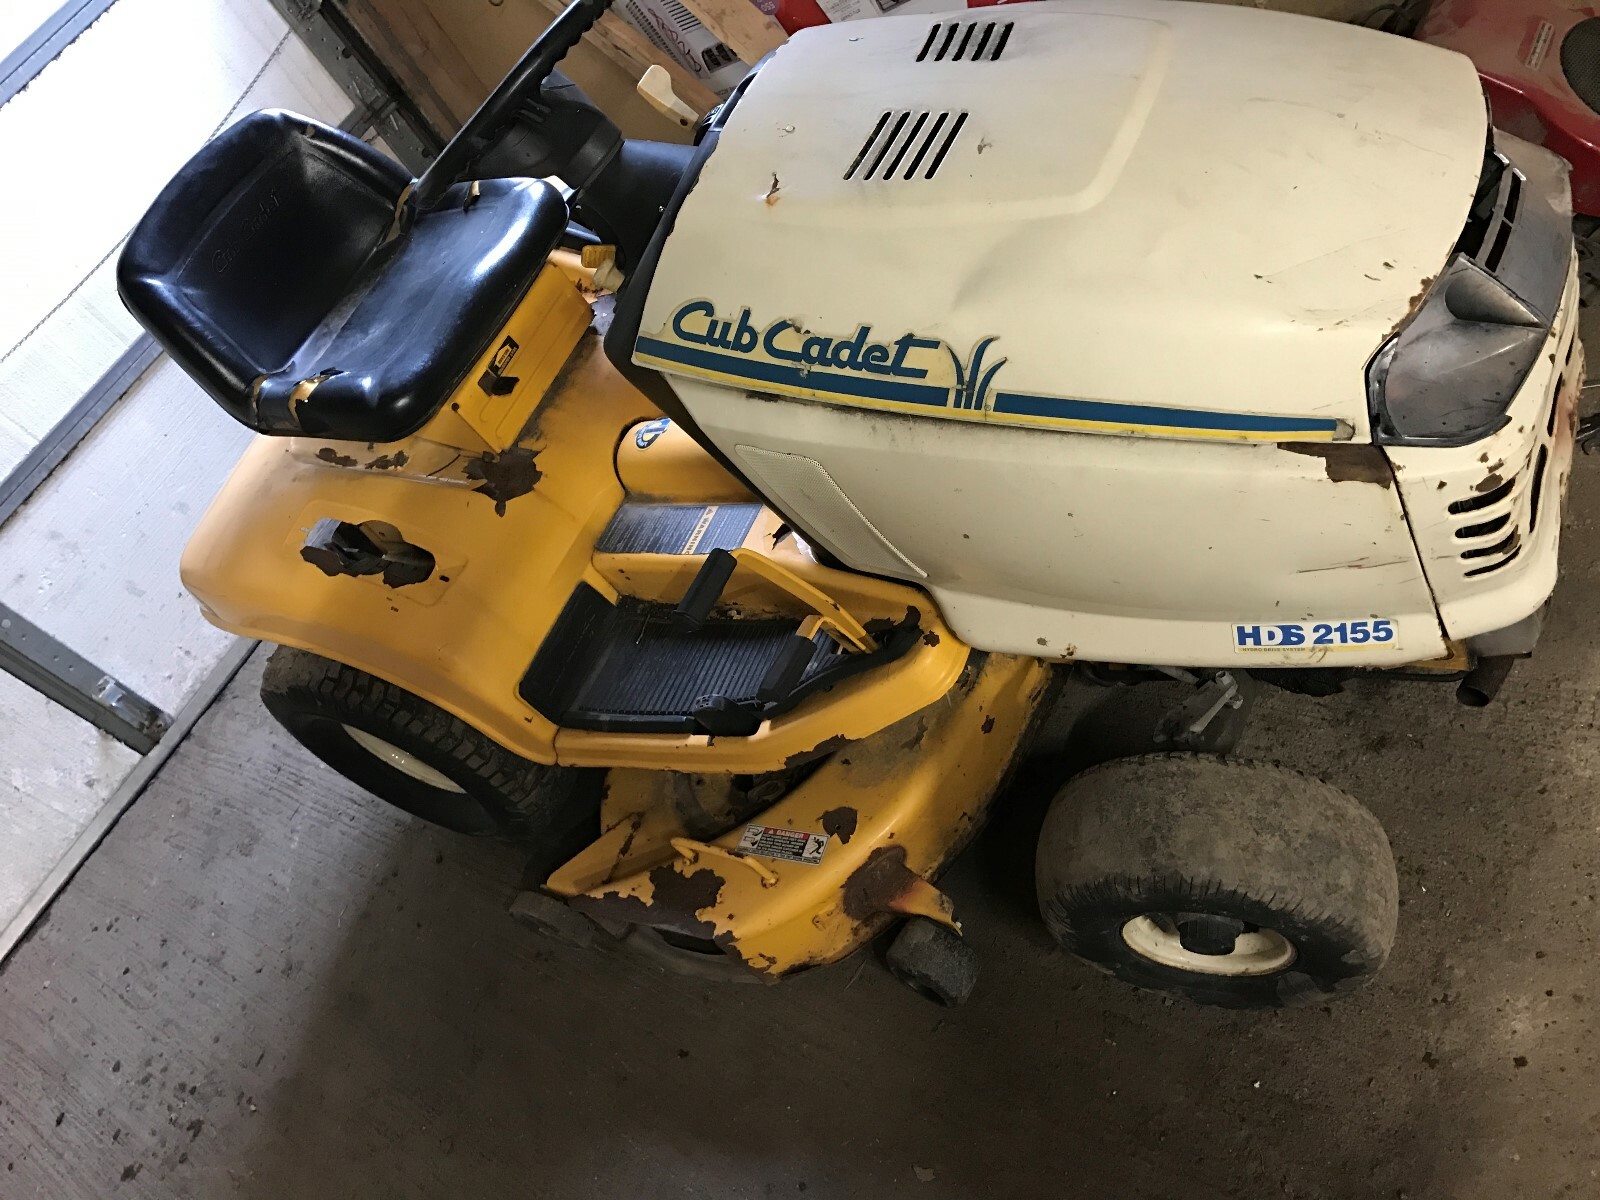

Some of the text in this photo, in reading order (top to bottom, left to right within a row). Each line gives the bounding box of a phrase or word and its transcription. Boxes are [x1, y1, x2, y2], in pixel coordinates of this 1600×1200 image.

[672, 300, 941, 379] Cub Cadet
[1312, 620, 1394, 645] 2155
[775, 828, 805, 839] DANGER
